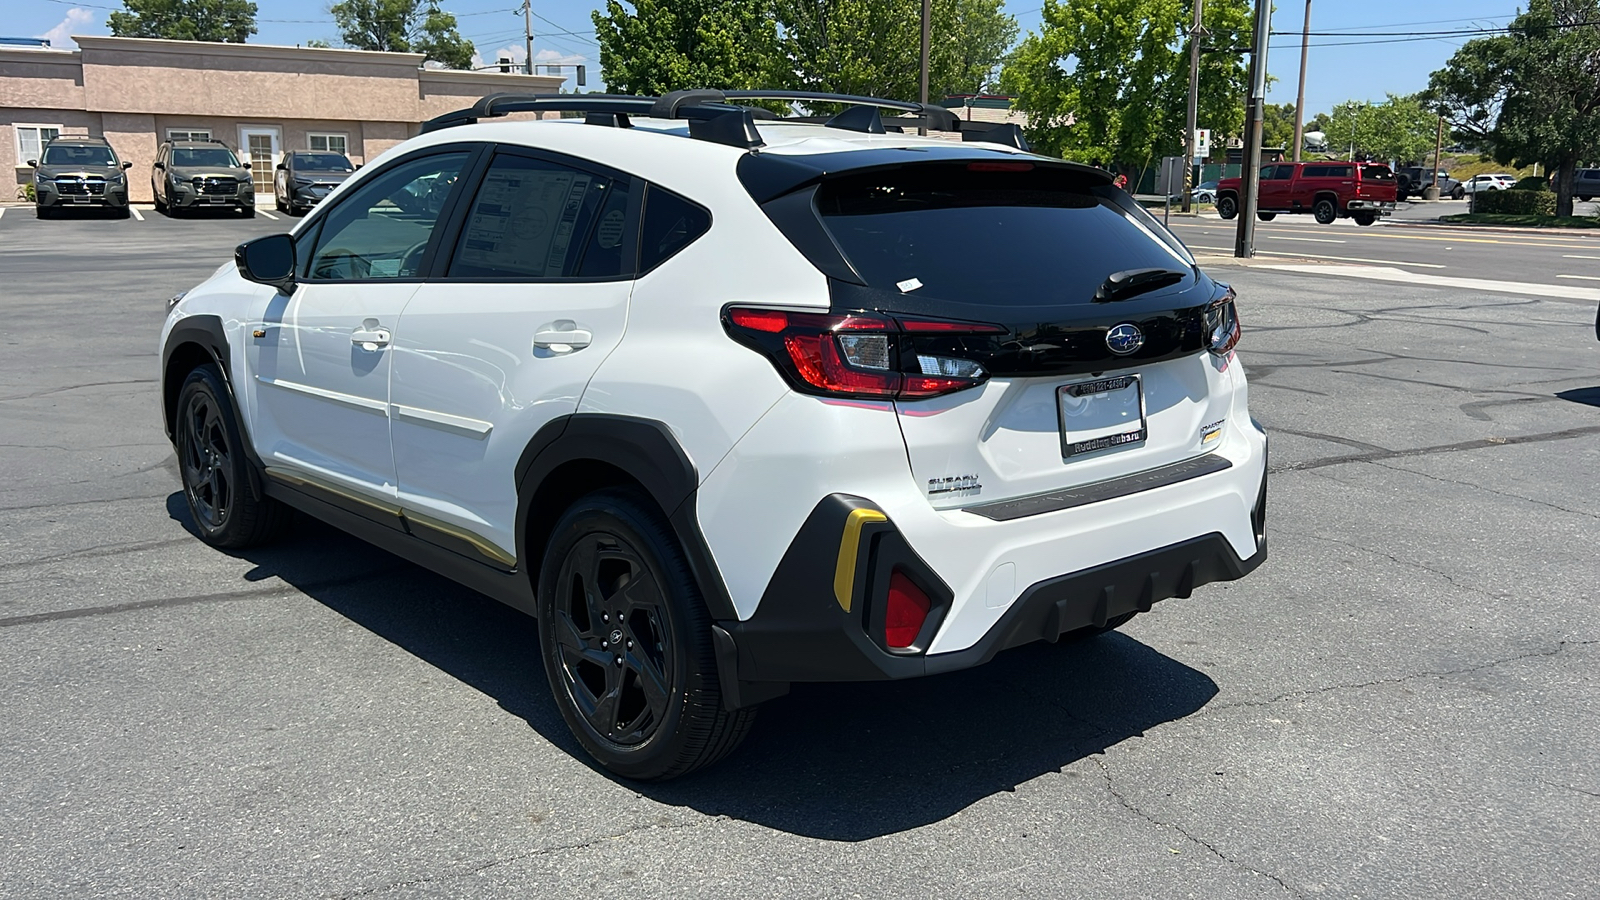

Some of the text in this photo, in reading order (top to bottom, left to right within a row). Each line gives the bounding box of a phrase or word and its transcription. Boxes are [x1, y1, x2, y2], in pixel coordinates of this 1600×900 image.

[1074, 432, 1140, 453] Redding Subaru
[928, 473, 979, 484] SUBARU
